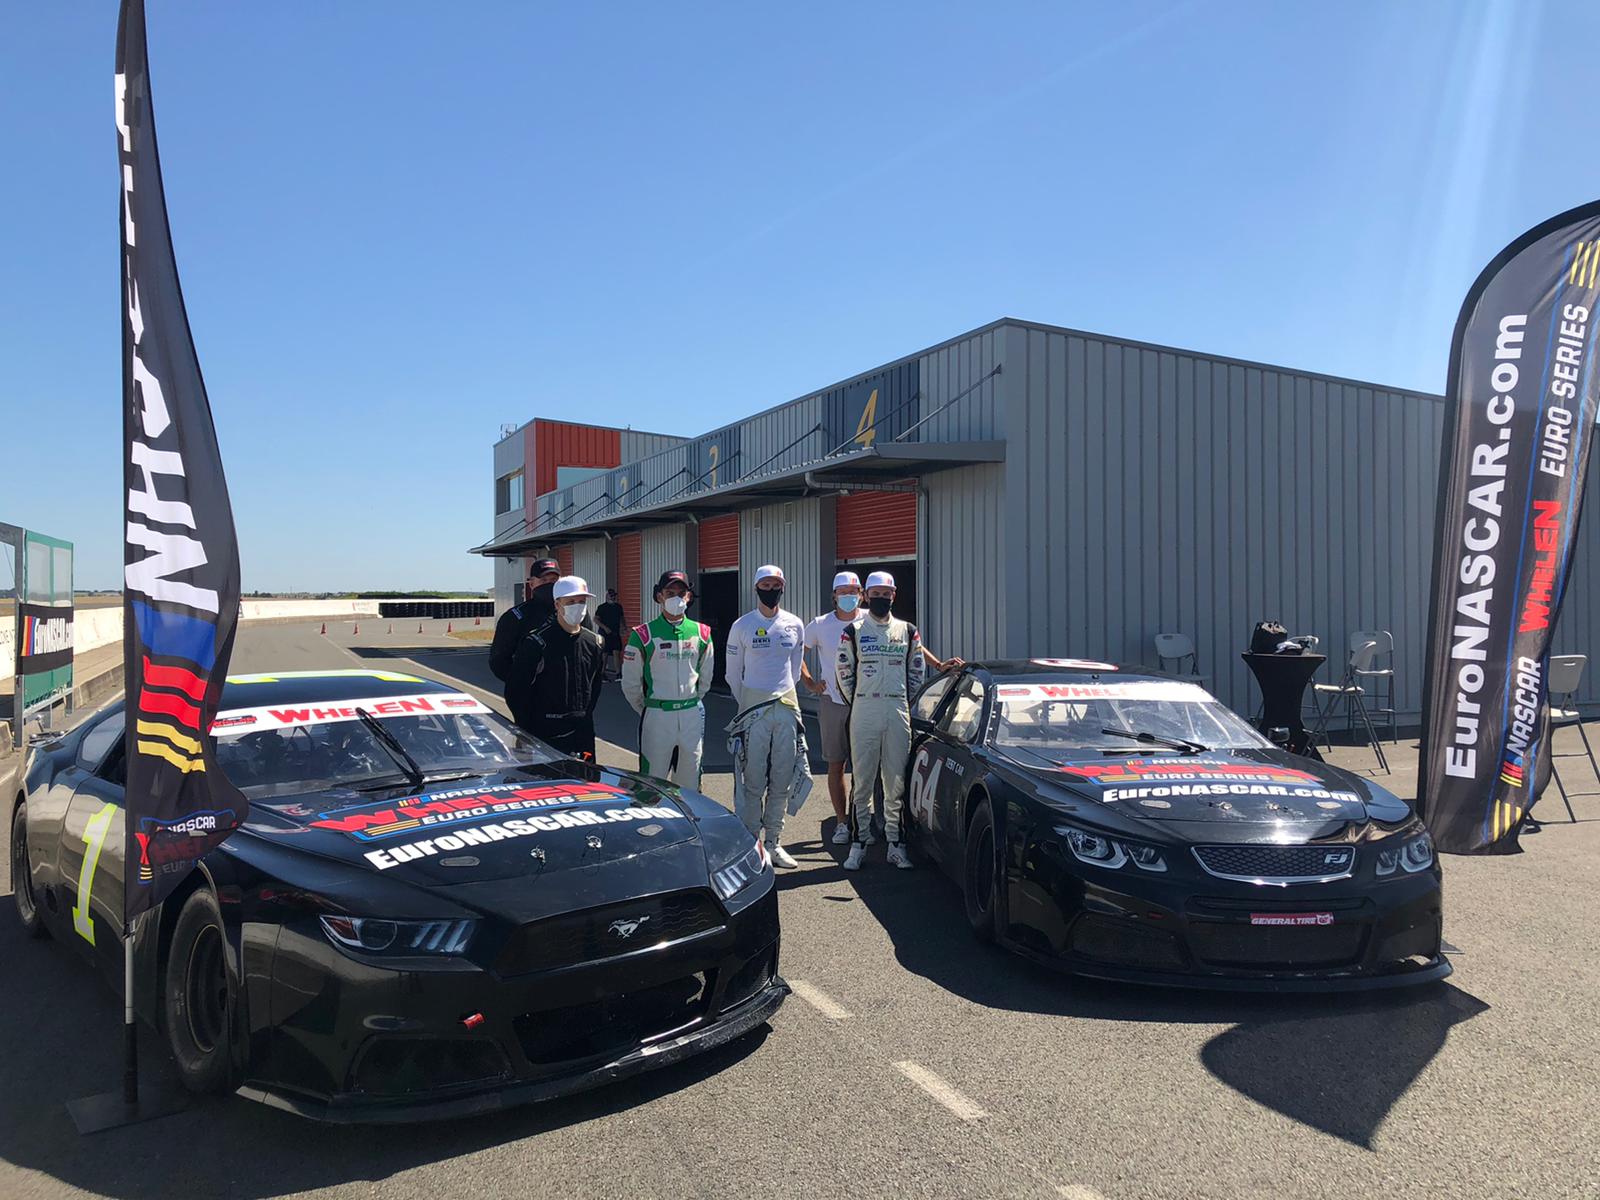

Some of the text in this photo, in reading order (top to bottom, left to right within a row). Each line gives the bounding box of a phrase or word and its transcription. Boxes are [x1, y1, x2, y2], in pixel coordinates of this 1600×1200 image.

[854, 388, 878, 449] 4
[1445, 314, 1528, 779] EuroNASCAR.com
[1505, 303, 1589, 756] NASCAR WHELEN EURO SERIES
[430, 785, 523, 801] NASCAR
[910, 744, 945, 832] 64
[1103, 783, 1359, 802] EuroNASCAR.com
[1143, 773, 1271, 781] EURO SERIES
[308, 782, 629, 832] WHELEN
[422, 796, 577, 826] EURO SERIES
[363, 804, 683, 871] EuroNASCAR.com
[72, 802, 118, 946] 1
[1297, 917, 1317, 925] TIRE
